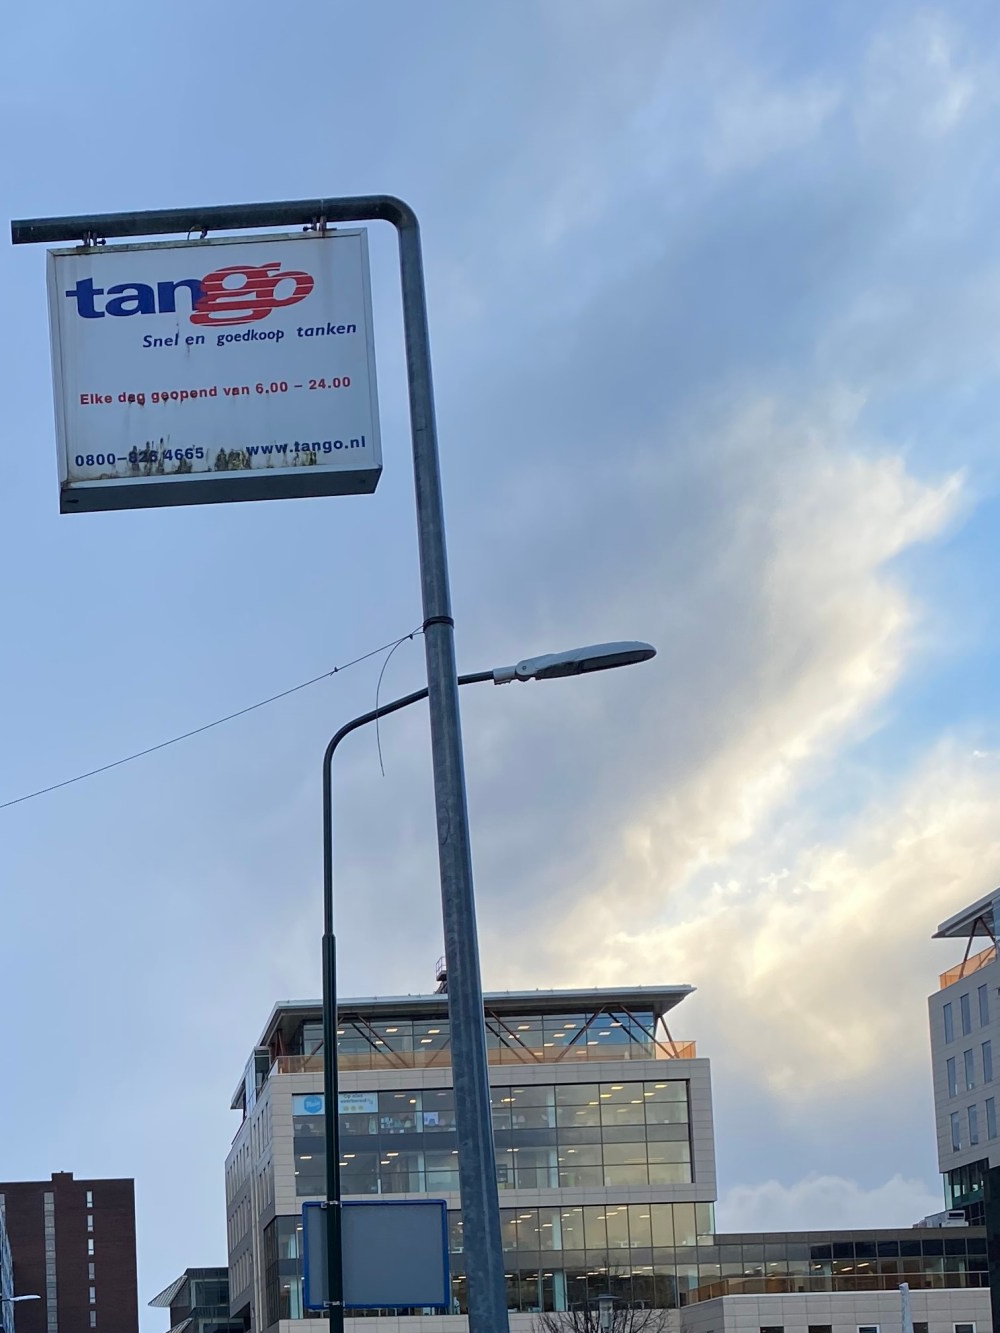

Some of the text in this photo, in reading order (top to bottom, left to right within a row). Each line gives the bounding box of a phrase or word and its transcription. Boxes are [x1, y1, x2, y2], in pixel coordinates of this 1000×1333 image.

[66, 262, 315, 327] tango
[143, 322, 357, 349] Snel en goedkoop tanken
[80, 392, 113, 405] Elke
[118, 393, 146, 407] dag
[151, 388, 218, 404] geopend
[223, 385, 250, 397] van
[255, 380, 288, 395] 6.00
[308, 376, 351, 391] 24.00
[246, 436, 366, 457] www.tango.nl
